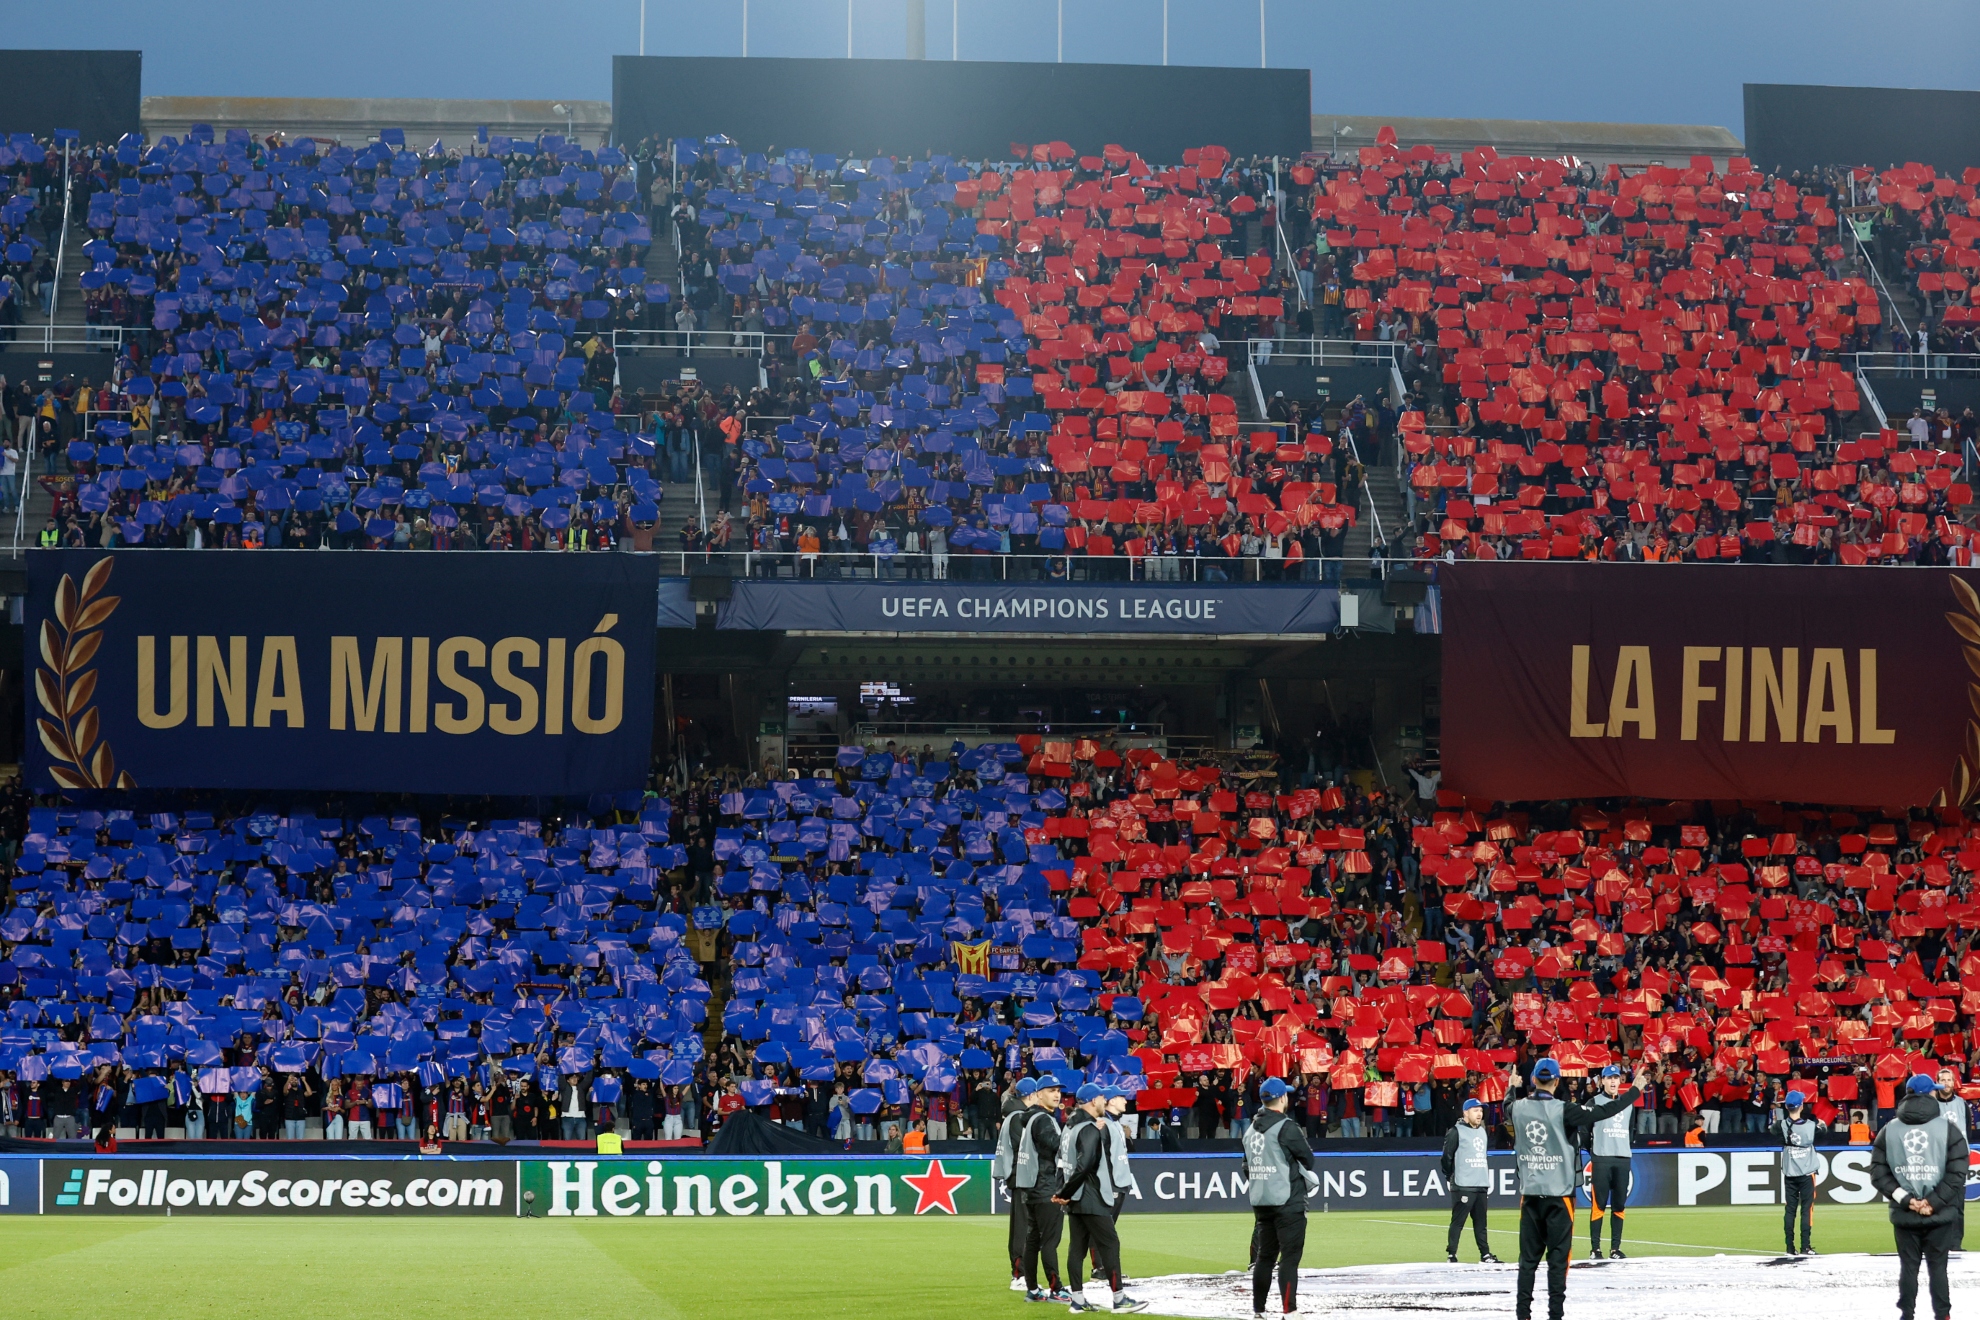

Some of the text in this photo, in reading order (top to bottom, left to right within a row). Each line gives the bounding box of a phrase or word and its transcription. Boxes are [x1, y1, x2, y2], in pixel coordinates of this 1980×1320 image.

[881, 597, 949, 617] UEFA
[957, 598, 1109, 619] CHAMPIONS
[136, 613, 625, 735] UNA MISSIÓ
[1569, 644, 1896, 744] LA FINAL
[1154, 1170, 1368, 1200] CHAMNS
[1383, 1168, 1517, 1198] LEAE
[1528, 1162, 1556, 1170] LEAGUE
[83, 1168, 503, 1207] FollowScores.com
[547, 1160, 897, 1217] Heineken
